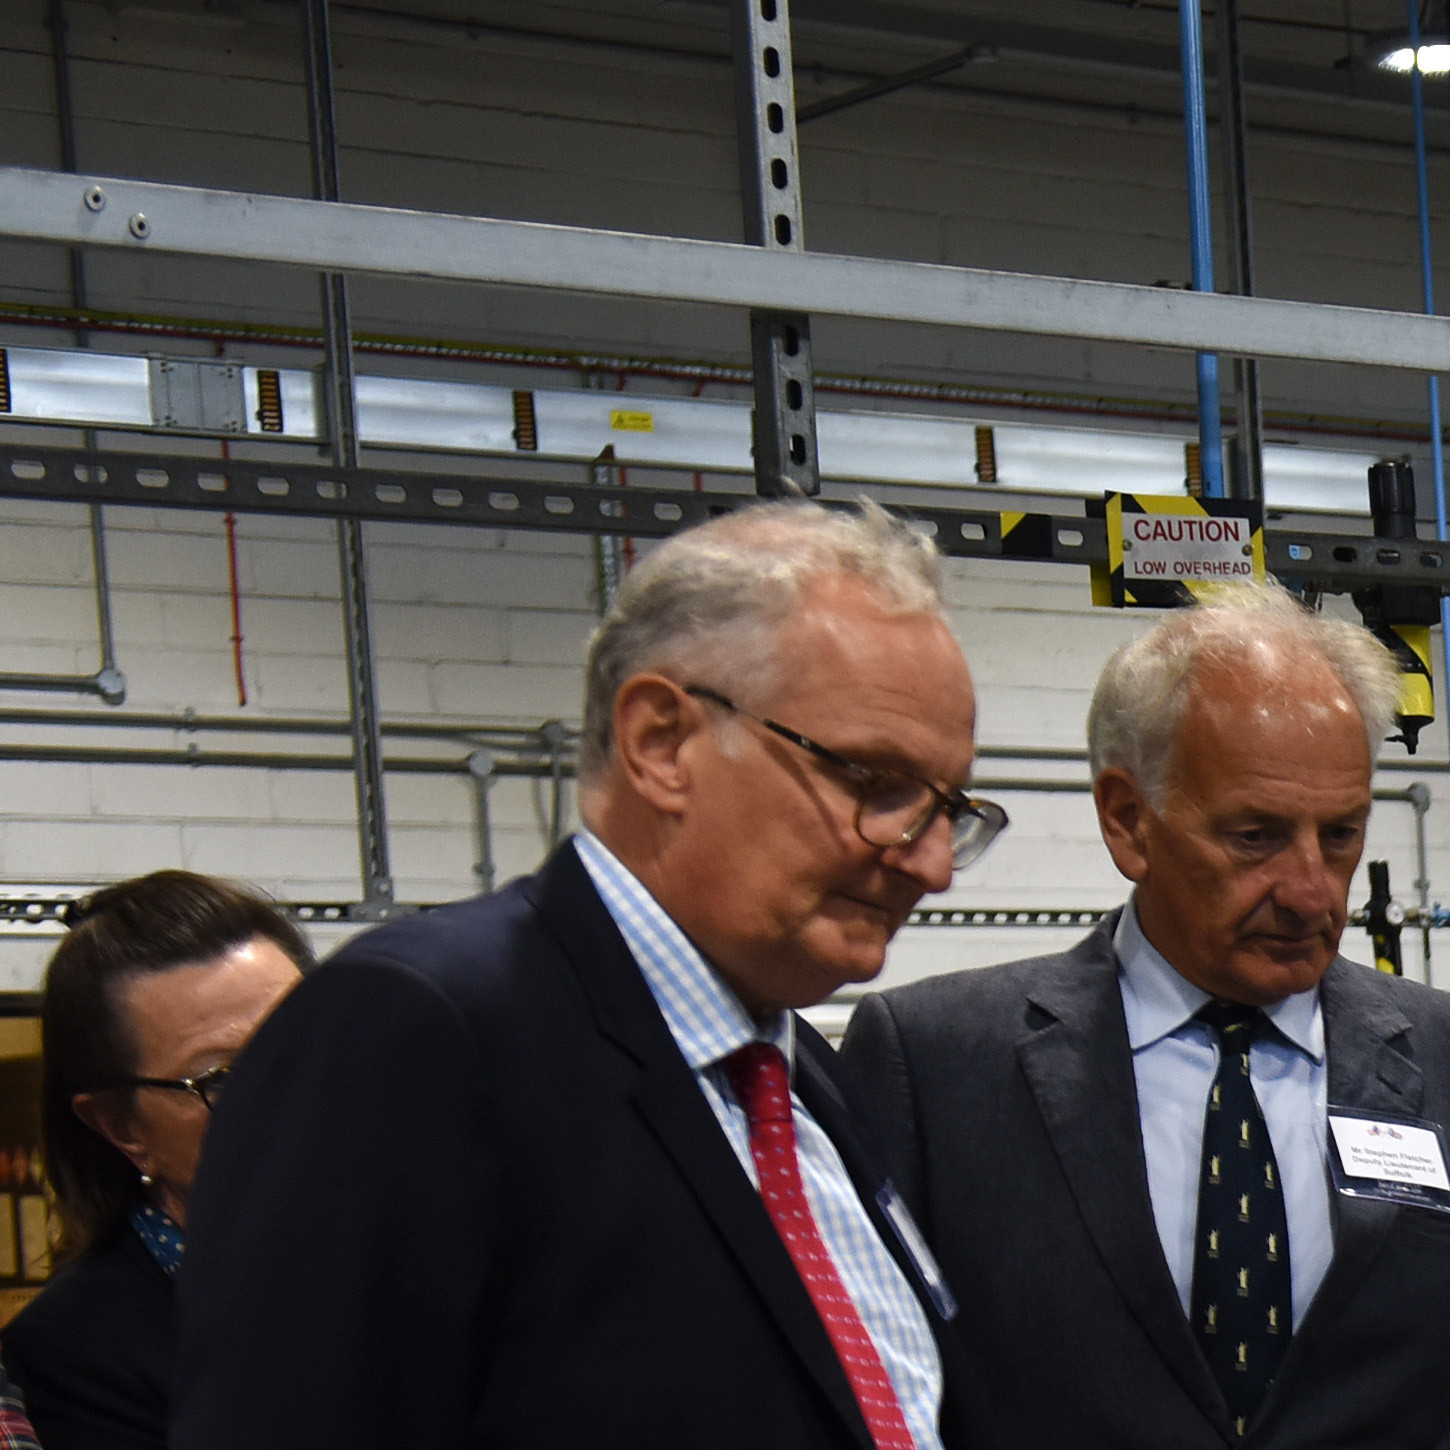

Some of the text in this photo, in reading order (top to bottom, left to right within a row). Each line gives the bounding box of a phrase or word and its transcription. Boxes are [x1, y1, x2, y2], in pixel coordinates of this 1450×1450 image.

[1133, 519, 1240, 542] CAUTION
[1133, 560, 1251, 576] LOW OVERHEAD
